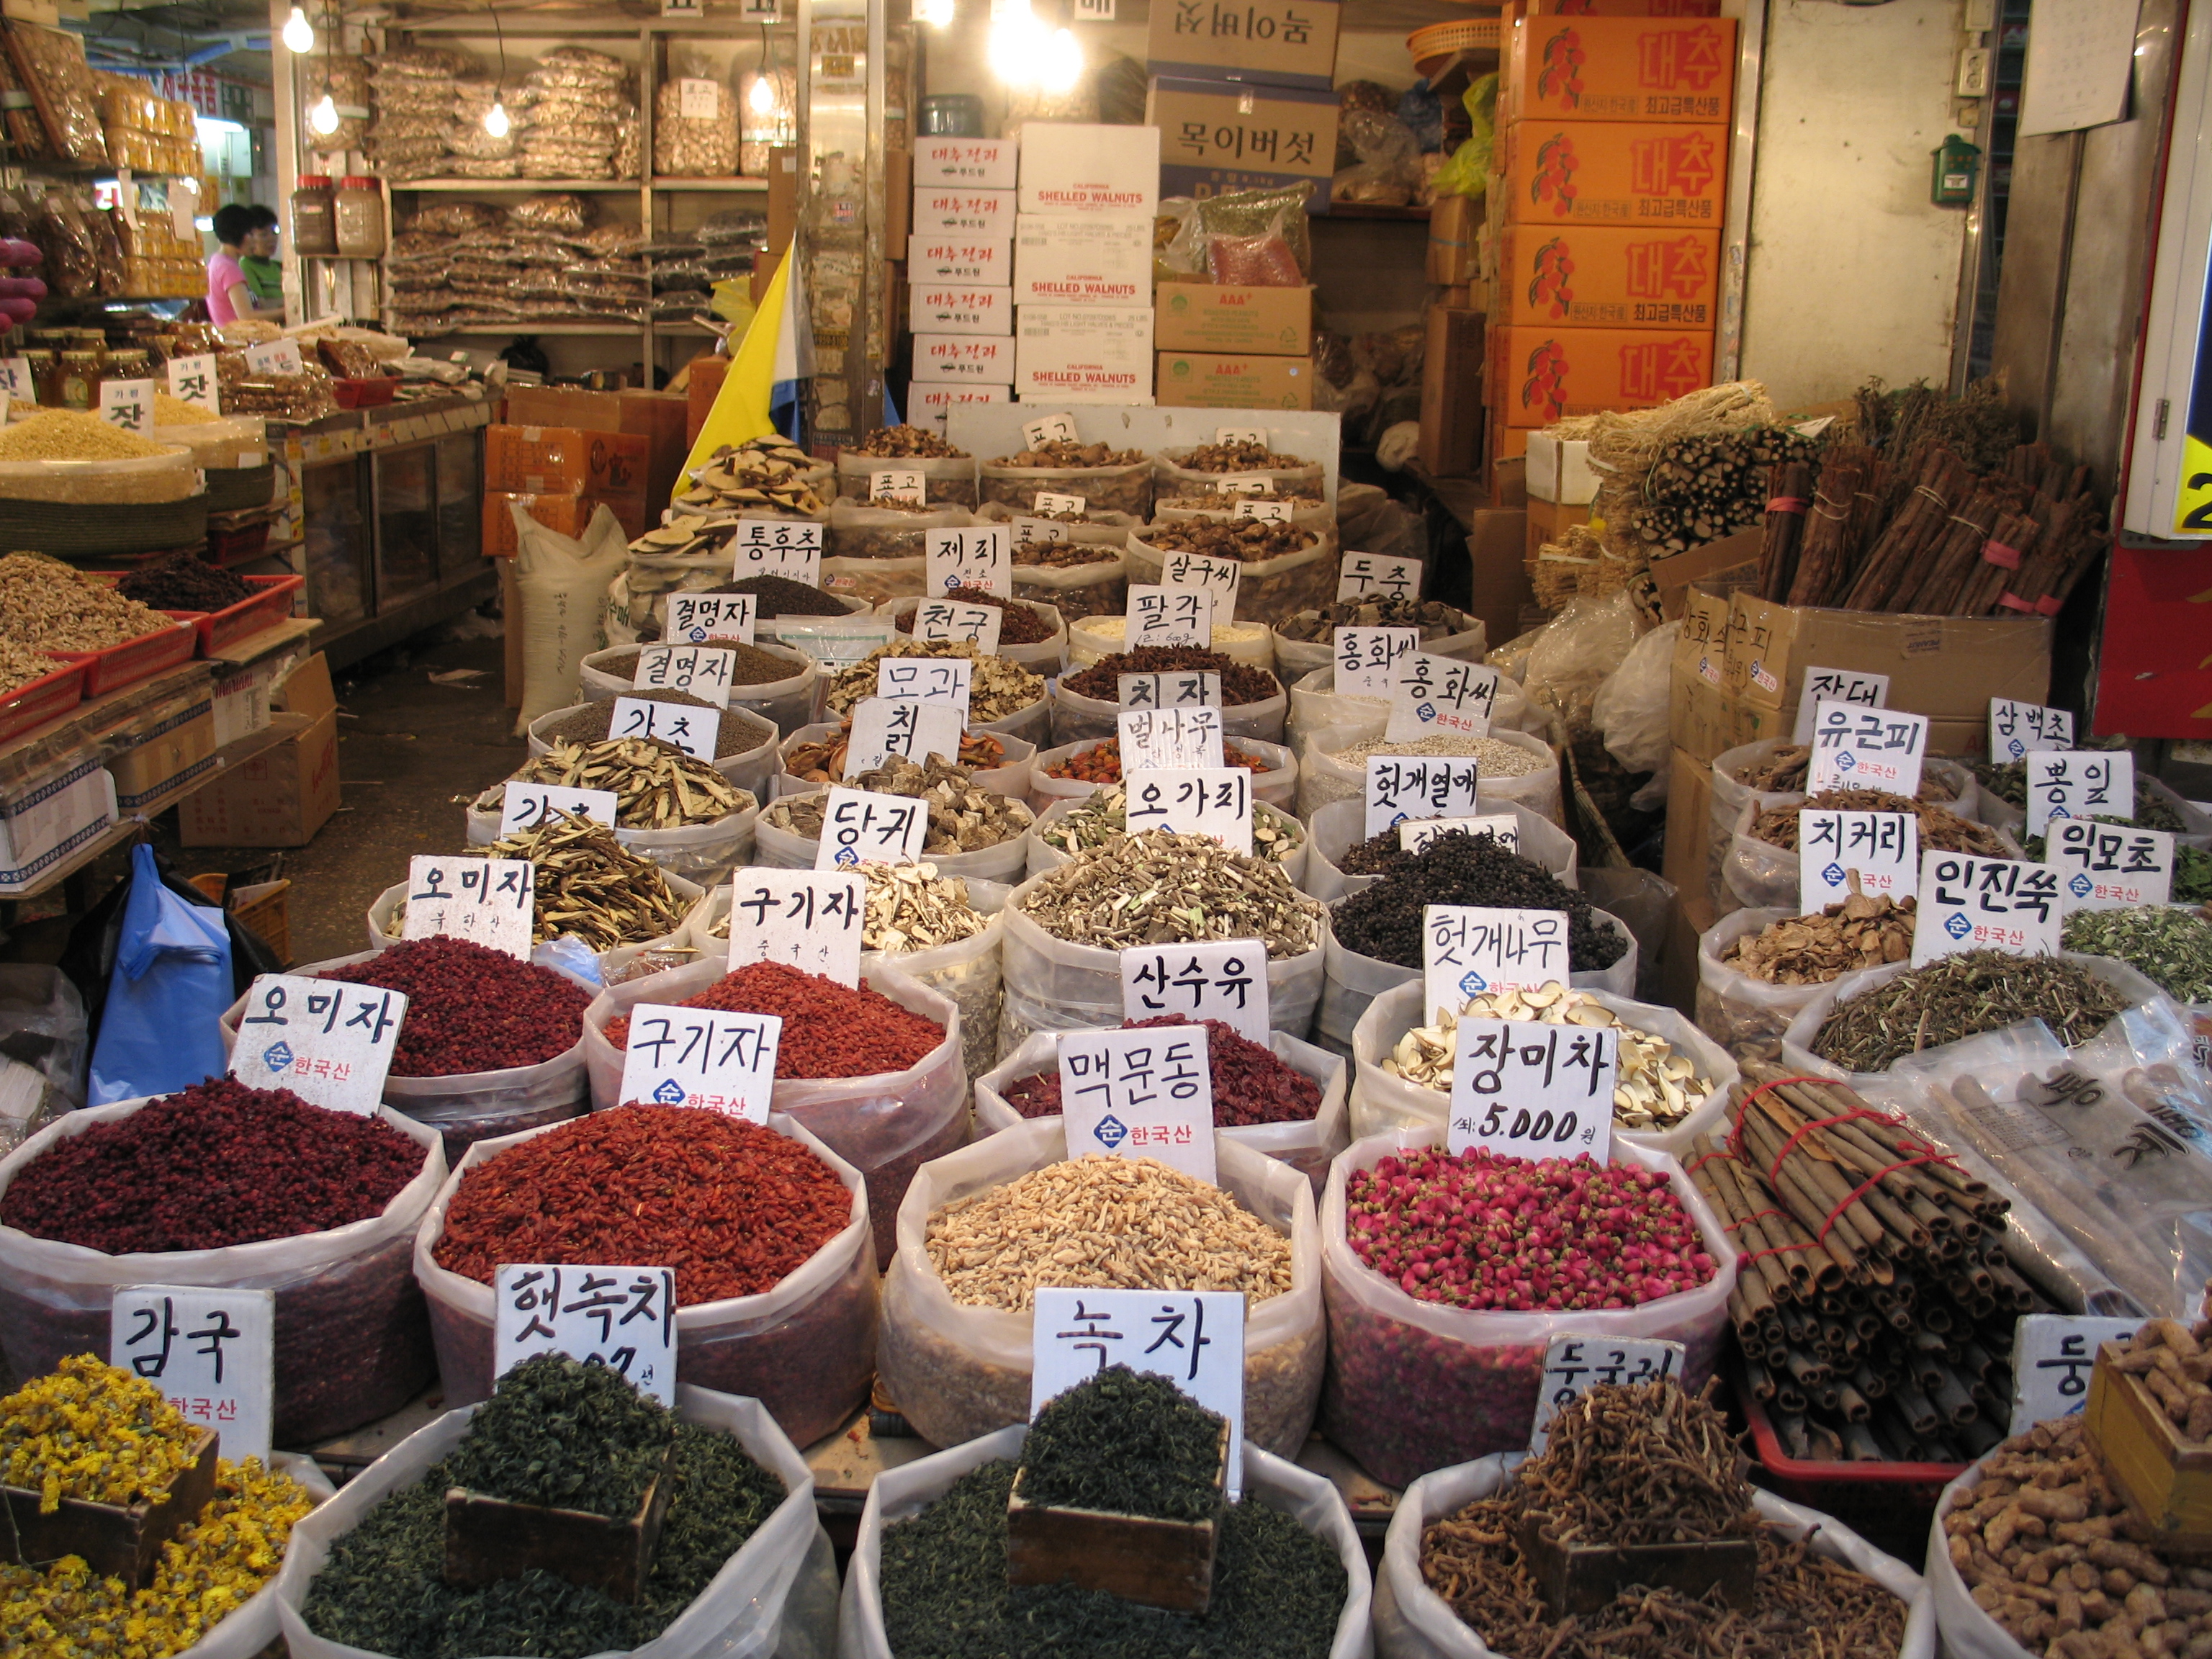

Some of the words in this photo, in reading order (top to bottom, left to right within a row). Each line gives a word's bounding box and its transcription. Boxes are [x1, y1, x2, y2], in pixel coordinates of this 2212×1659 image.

[1639, 24, 1722, 91] 대추
[1177, 122, 1314, 164] 목이버섯
[1630, 131, 1714, 197] 대추
[1038, 191, 1087, 202] SHELLED
[1092, 192, 1143, 204] WALNUTS
[1626, 235, 1707, 299] 대추
[1032, 282, 1080, 293] SHELLED
[1085, 283, 1136, 295] WALNUTS
[179, 374, 209, 401] 잣
[1033, 372, 1081, 382] SHELLED
[1086, 372, 1136, 384] WALNUTS
[1619, 338, 1701, 400] 대추
[109, 403, 144, 430] 잣
[876, 475, 918, 492] 표고
[740, 526, 822, 564] 통후추
[1170, 554, 1237, 592] 살구씨
[1344, 560, 1411, 601] 두충
[676, 598, 750, 631] 결명자
[923, 605, 989, 642] 천궁
[1136, 594, 1202, 631] 팔각
[647, 649, 728, 688] 결명자
[884, 667, 965, 699] 모과
[1400, 658, 1498, 719] 홍화씨
[1128, 671, 1210, 709] 치자
[1437, 712, 1473, 732] 한국산
[1817, 711, 1920, 755] 유근피
[1995, 701, 2071, 742] 삼백초
[1373, 763, 1477, 808] 헛개열매
[1858, 761, 1897, 779] 한국산
[835, 801, 917, 855] 당귀
[1807, 814, 1905, 863] 치커리
[2062, 824, 2162, 873] 익모초
[411, 863, 532, 909] 오미자
[1935, 860, 2059, 924] 인진쑥
[2094, 884, 2139, 903] 한국산
[740, 884, 859, 930] 구기자
[757, 940, 830, 962] 중국산
[1430, 914, 1562, 968] 헛개나무
[1974, 925, 2025, 947] 한국산
[1132, 955, 1253, 1009] 산수유
[245, 985, 395, 1044] 오미자
[632, 1019, 770, 1074] 구기자
[1468, 1024, 1609, 1097] 장미차
[295, 1056, 351, 1081] 한국산
[1067, 1042, 1200, 1108] 맥문동
[1130, 1124, 1192, 1146] 한국산
[511, 1267, 677, 1349] 햇녹차
[126, 1296, 241, 1384] 감국
[1056, 1297, 1211, 1381] 녹차
